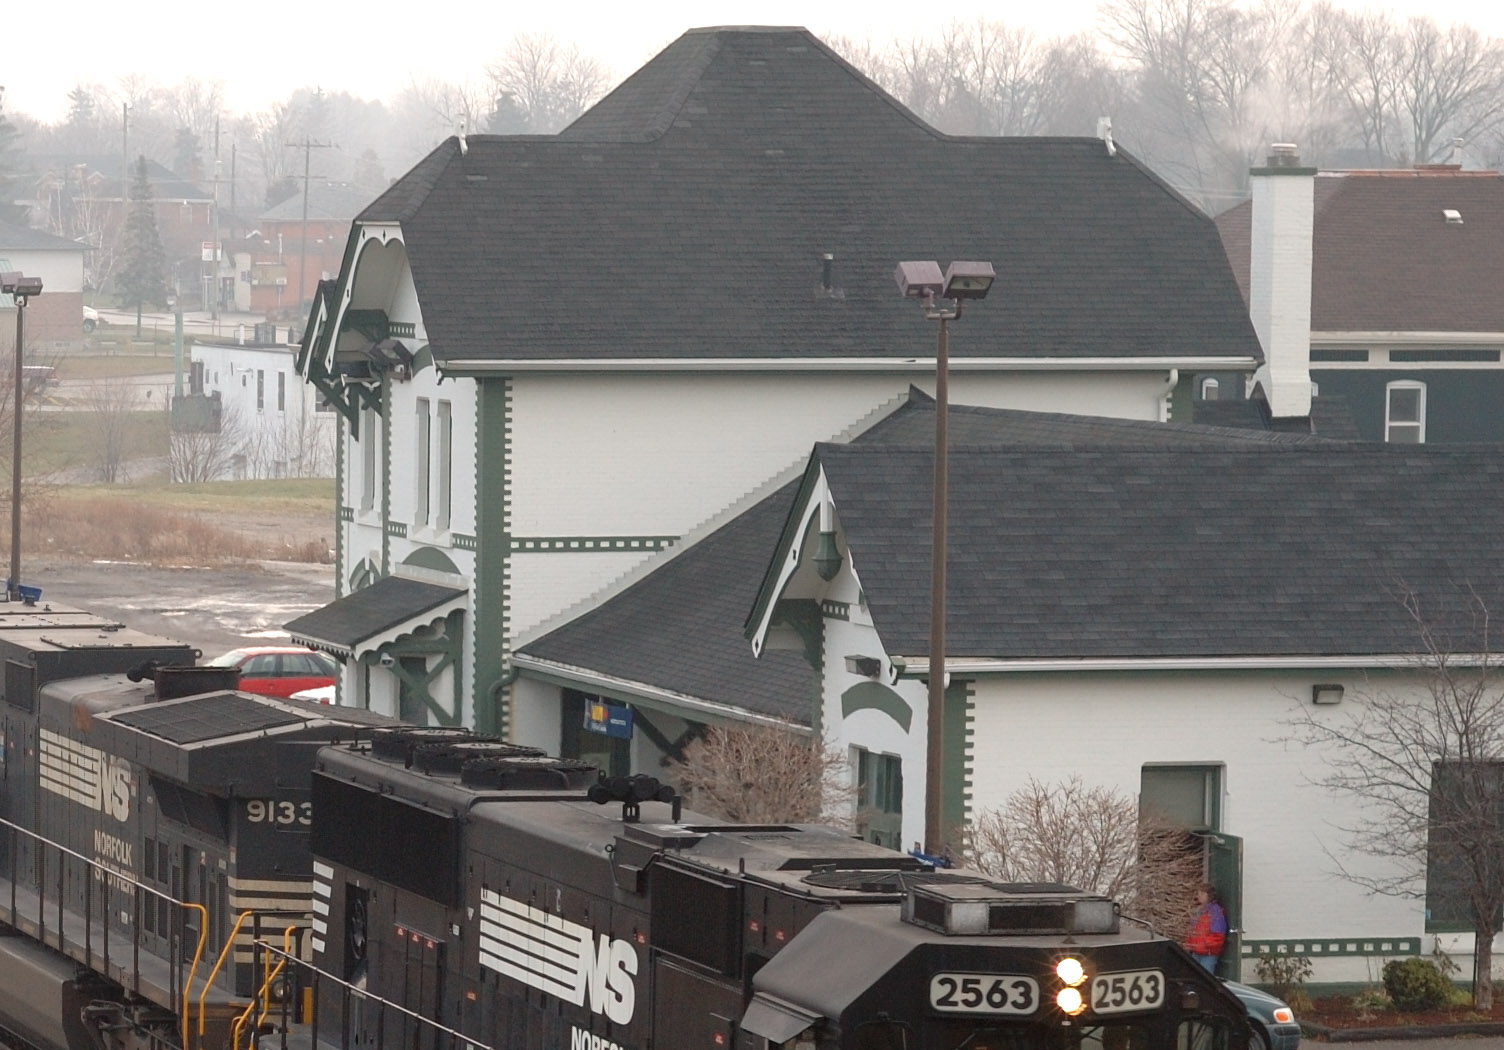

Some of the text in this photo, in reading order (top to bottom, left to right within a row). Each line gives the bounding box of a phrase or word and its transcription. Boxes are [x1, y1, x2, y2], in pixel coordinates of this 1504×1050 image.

[247, 800, 312, 825] 9133
[94, 829, 133, 867] NORFOLK
[936, 977, 1033, 1010] 2563
[1095, 974, 1161, 1009] 2563
